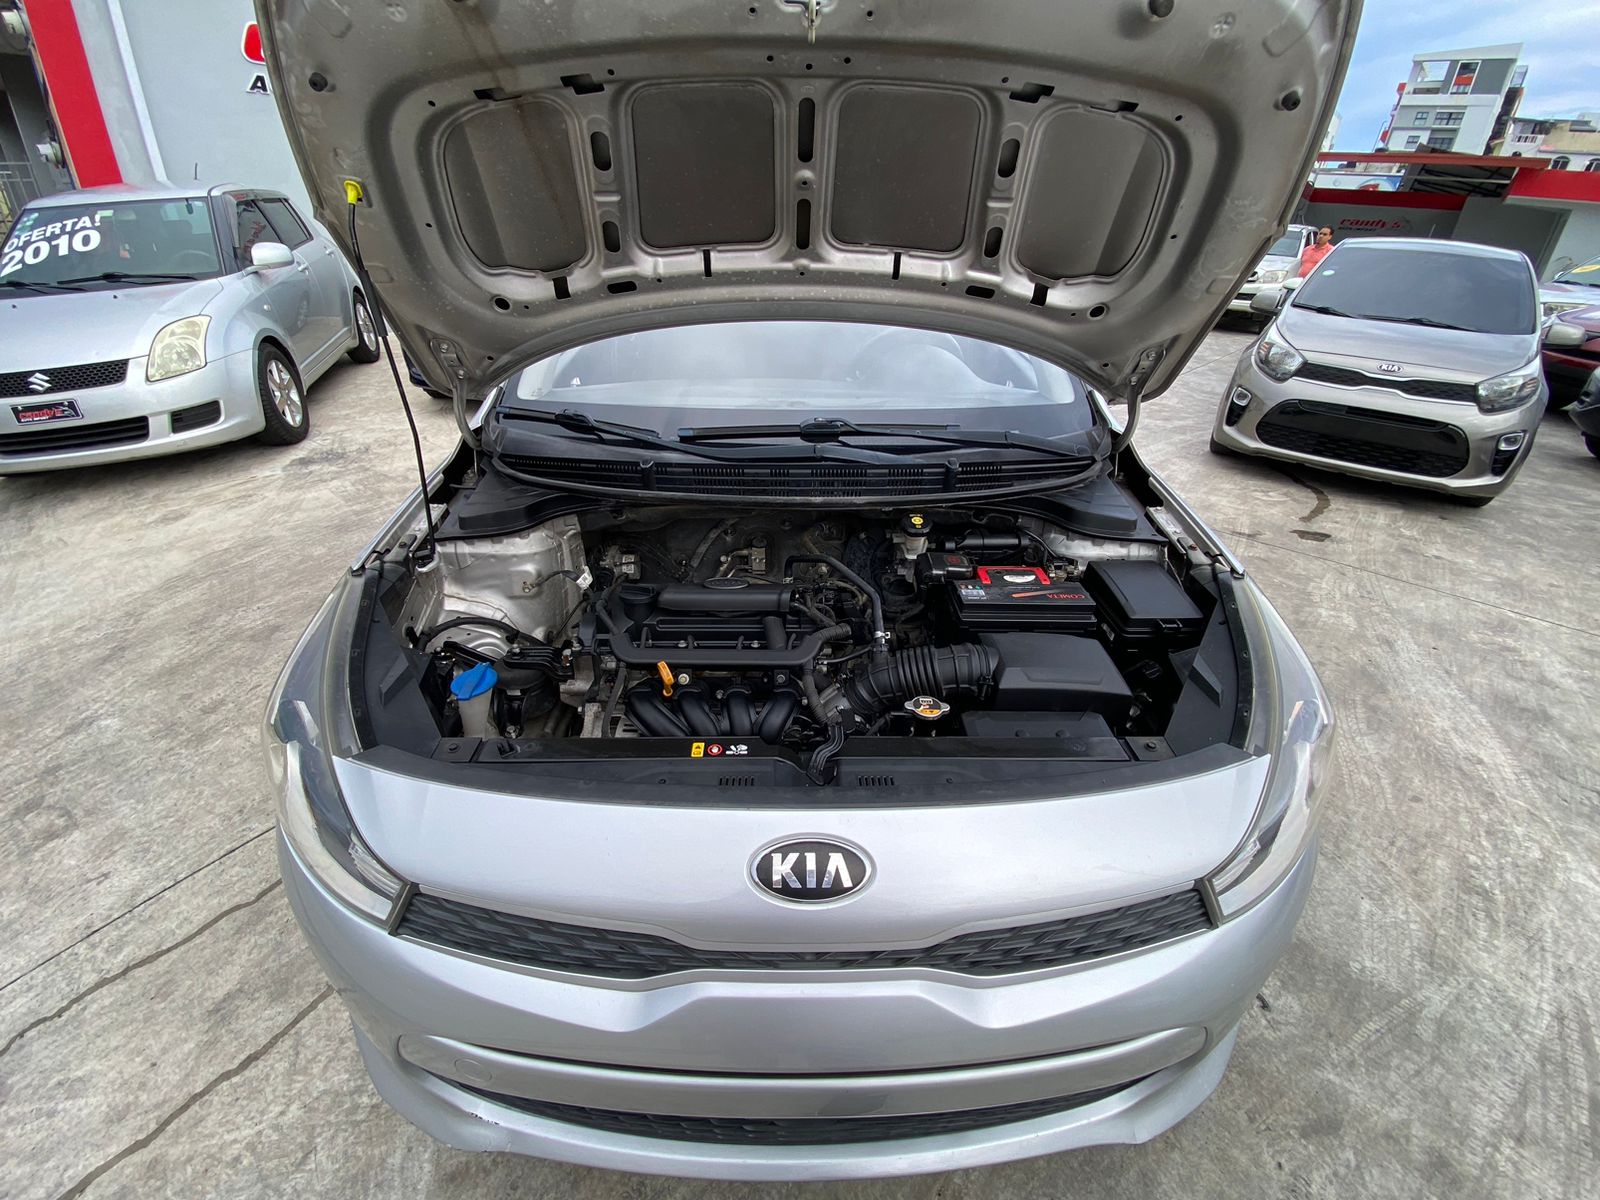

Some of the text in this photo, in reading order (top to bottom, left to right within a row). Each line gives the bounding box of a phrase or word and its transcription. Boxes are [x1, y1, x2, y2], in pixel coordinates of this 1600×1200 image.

[3, 214, 101, 253] OFERTA!
[0, 229, 101, 278] 2010
[771, 852, 853, 888] KIA
